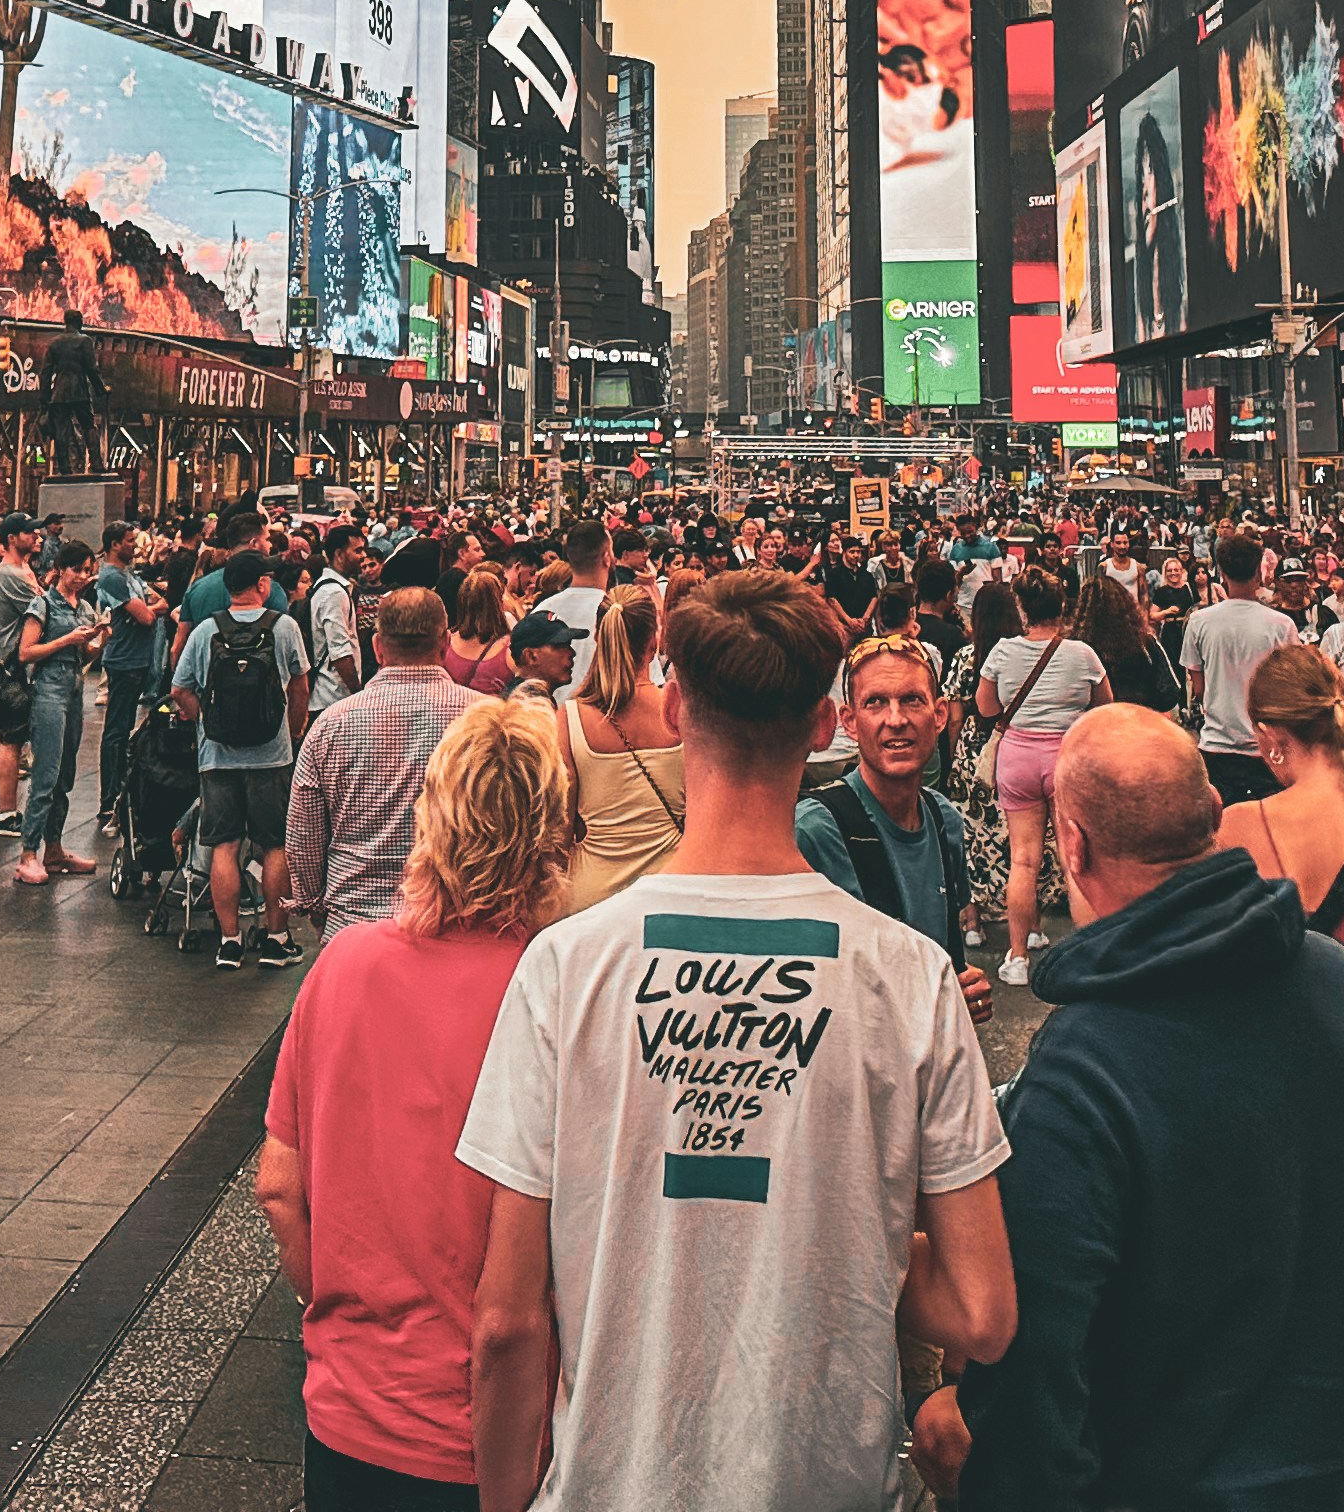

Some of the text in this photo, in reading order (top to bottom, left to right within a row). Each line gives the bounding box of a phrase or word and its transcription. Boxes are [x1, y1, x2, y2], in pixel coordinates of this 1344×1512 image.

[563, 175, 574, 228] 1500
[886, 297, 976, 322] GARNIER
[179, 366, 265, 409] FOREVER 21
[328, 381, 348, 397] POLO
[414, 385, 468, 419] sunglass hut
[1032, 386, 1056, 395] START
[1057, 386, 1078, 395] YOUR
[1067, 428, 1108, 441] YORK
[635, 956, 816, 1005] LOUIS
[636, 1001, 833, 1069] VUITTON
[648, 1053, 798, 1096] MALLETIER
[672, 1088, 763, 1120] PARIS
[681, 1121, 745, 1152] 1854
